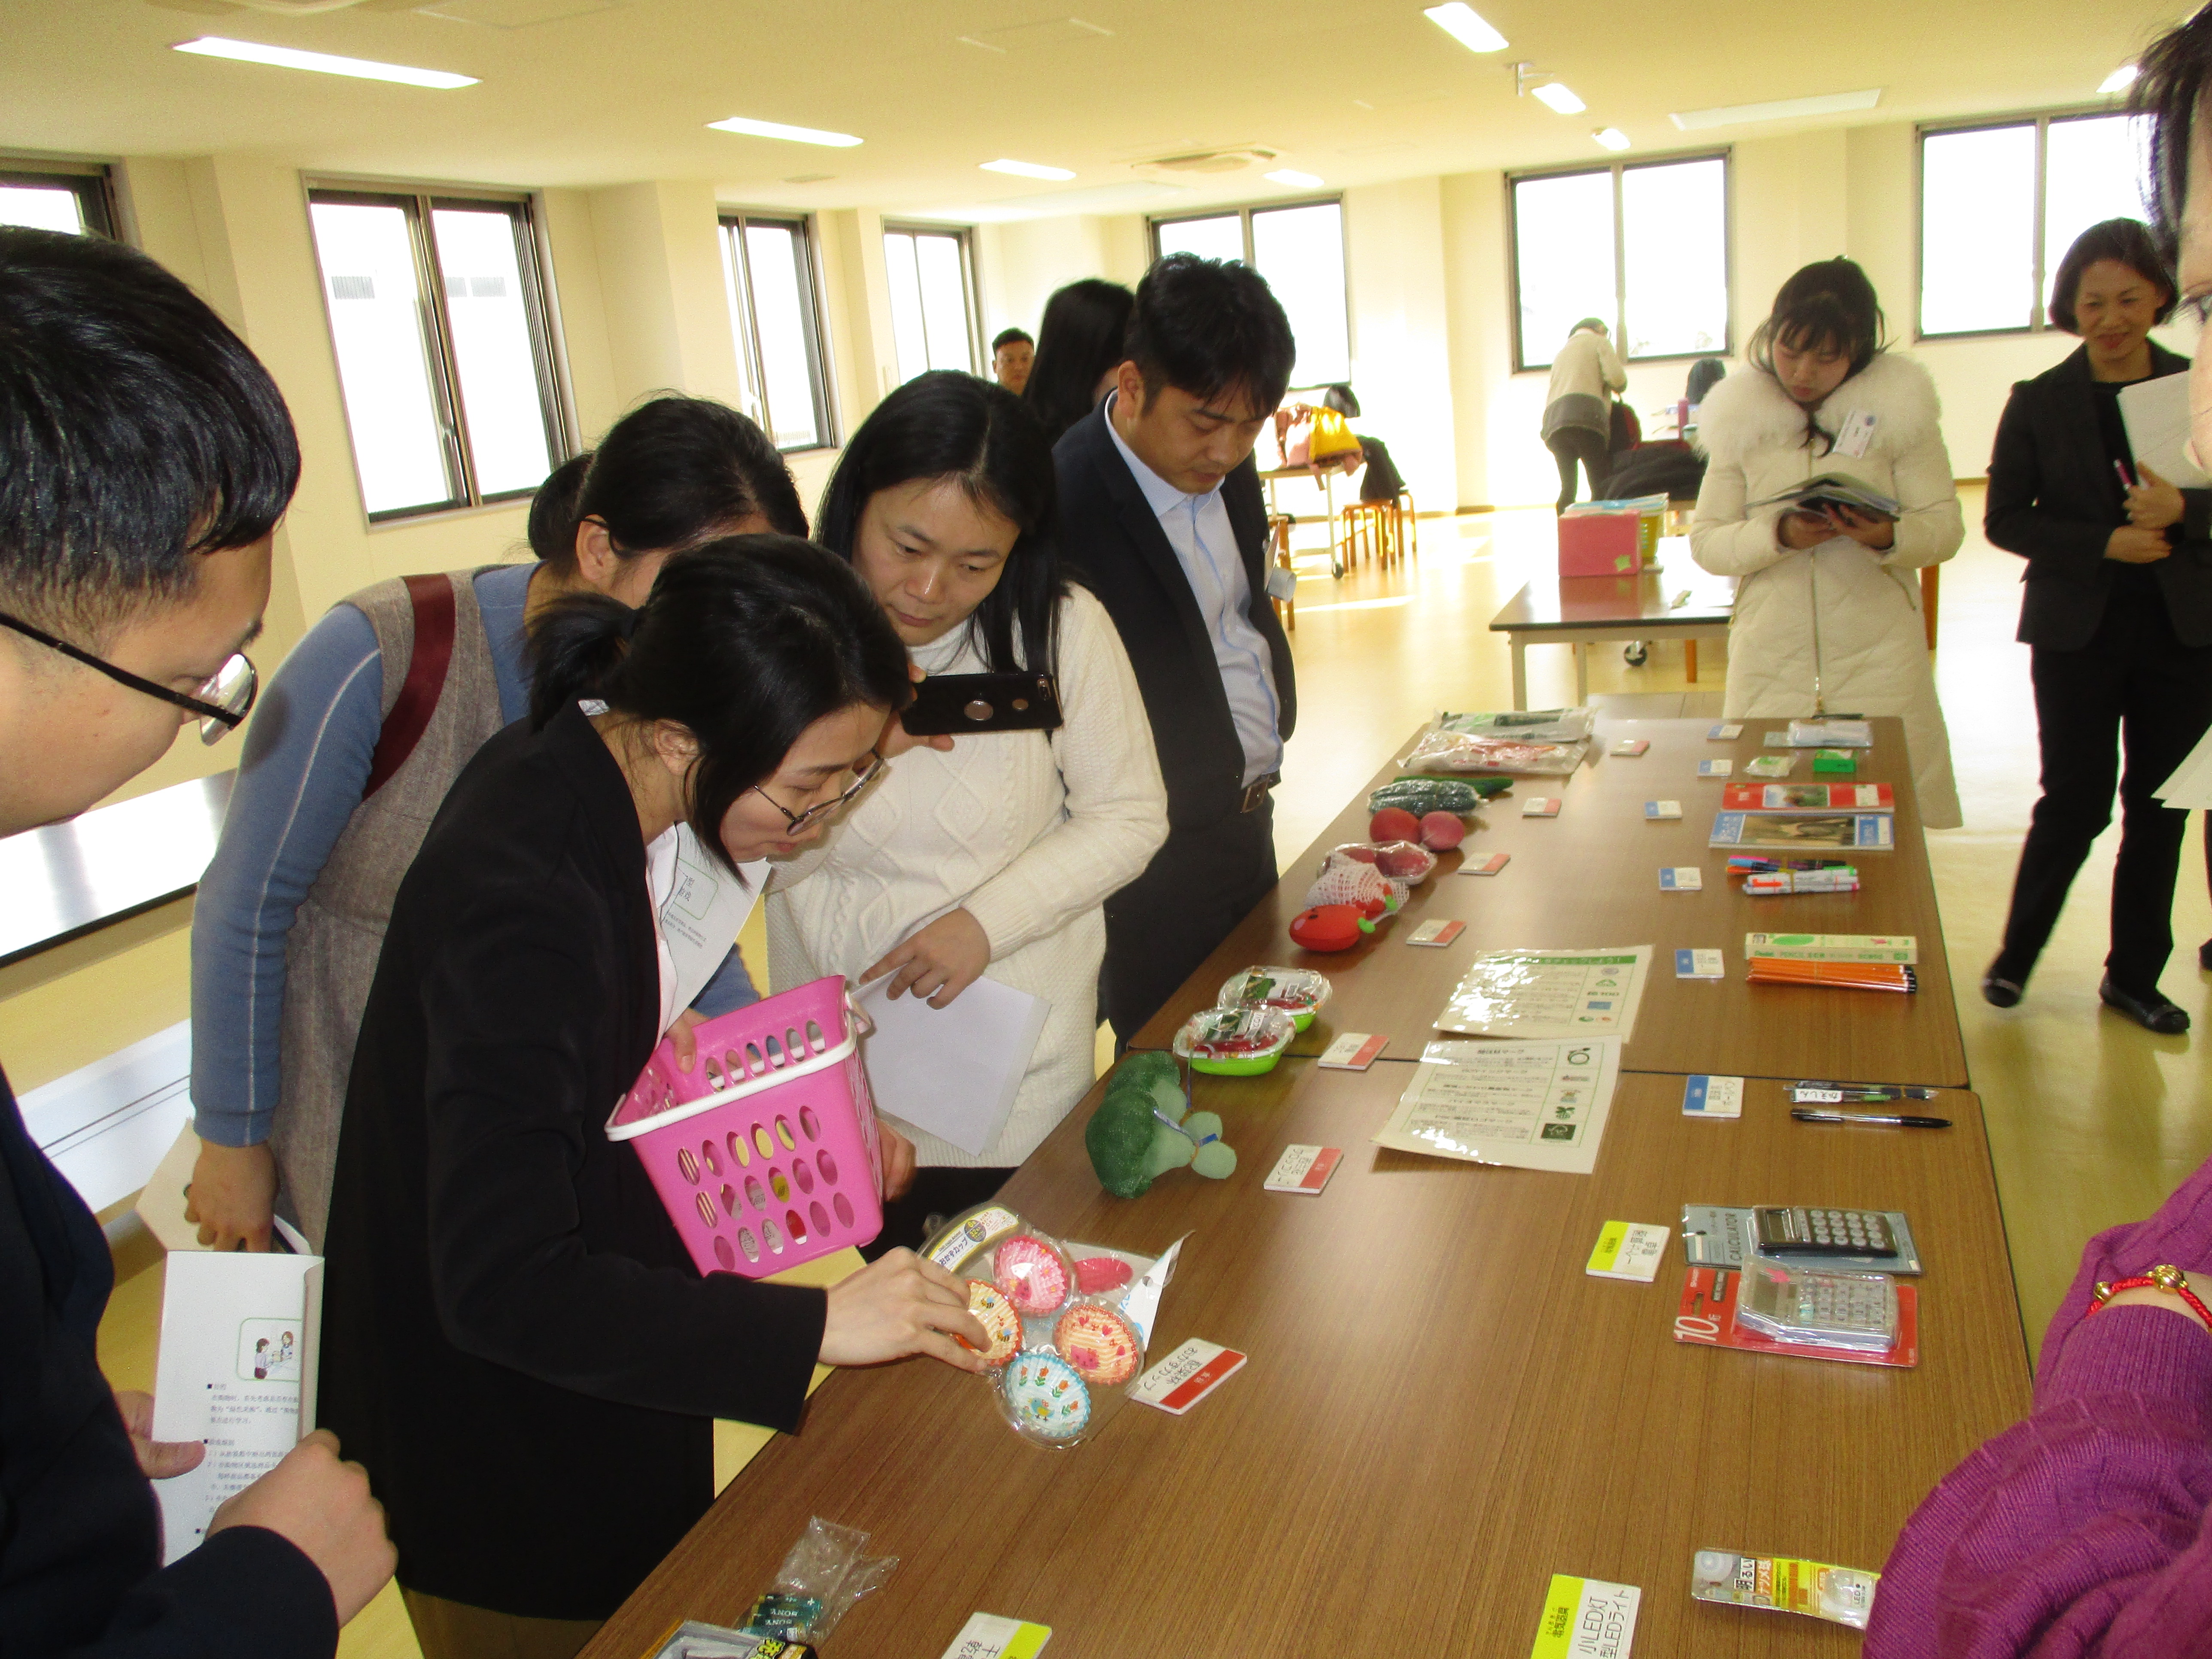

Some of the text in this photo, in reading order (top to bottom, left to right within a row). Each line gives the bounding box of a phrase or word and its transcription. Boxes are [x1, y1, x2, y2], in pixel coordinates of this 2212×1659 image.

[939, 1237, 969, 1266] おかずカップ
[1726, 1213, 1741, 1260] CALCULATOR
[1142, 1346, 1197, 1391] おかずカップ
[1735, 1559, 1755, 1590] 明るい
[1578, 1596, 1608, 1654] 小LED灯
